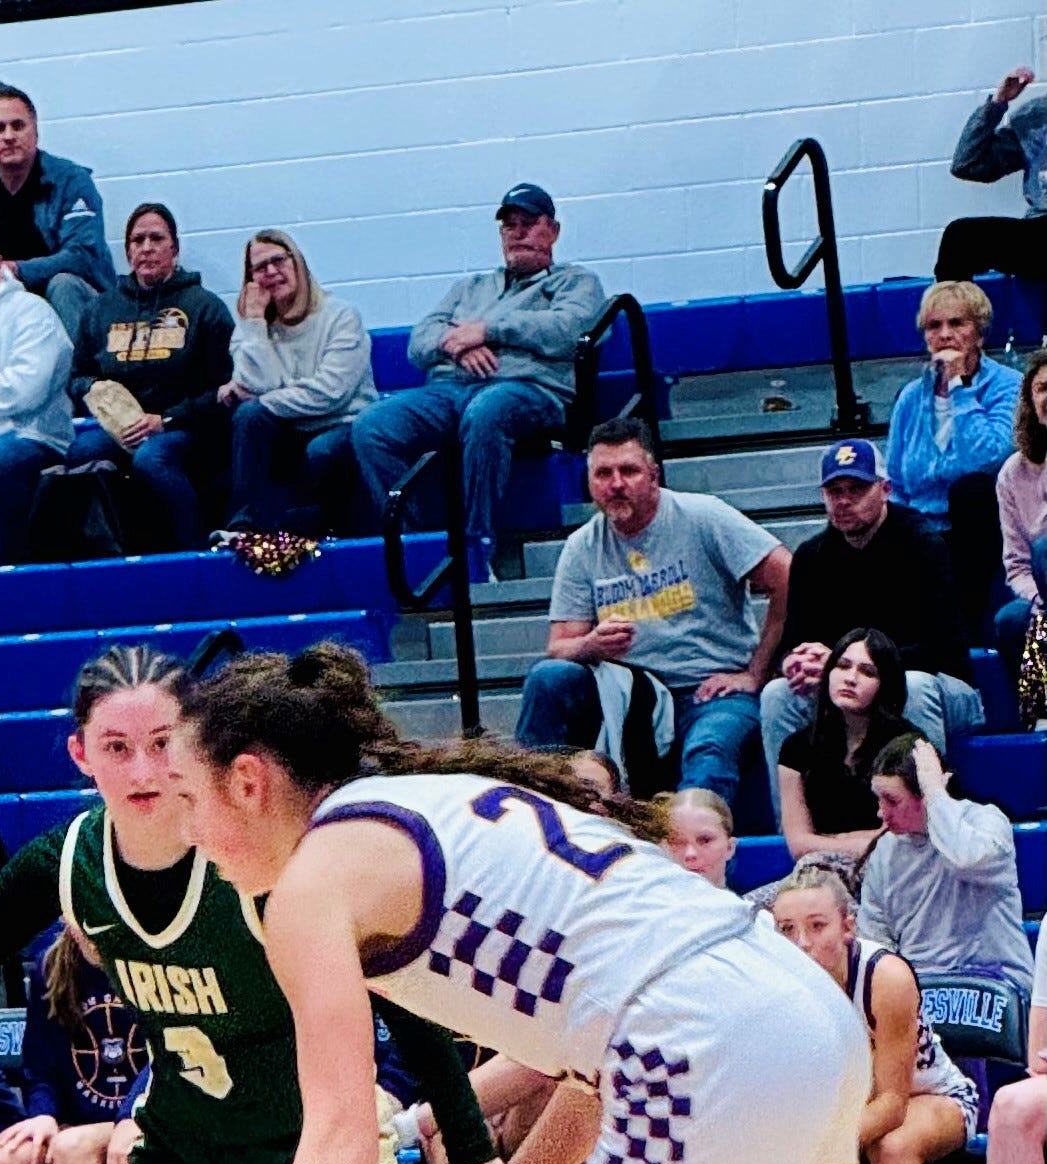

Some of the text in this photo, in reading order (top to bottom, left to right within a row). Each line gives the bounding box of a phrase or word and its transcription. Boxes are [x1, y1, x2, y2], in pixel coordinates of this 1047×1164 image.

[470, 785, 634, 883] 2
[115, 959, 229, 1015] IRISH
[920, 987, 1008, 1033] ESVILLE
[163, 1025, 234, 1100] 3
